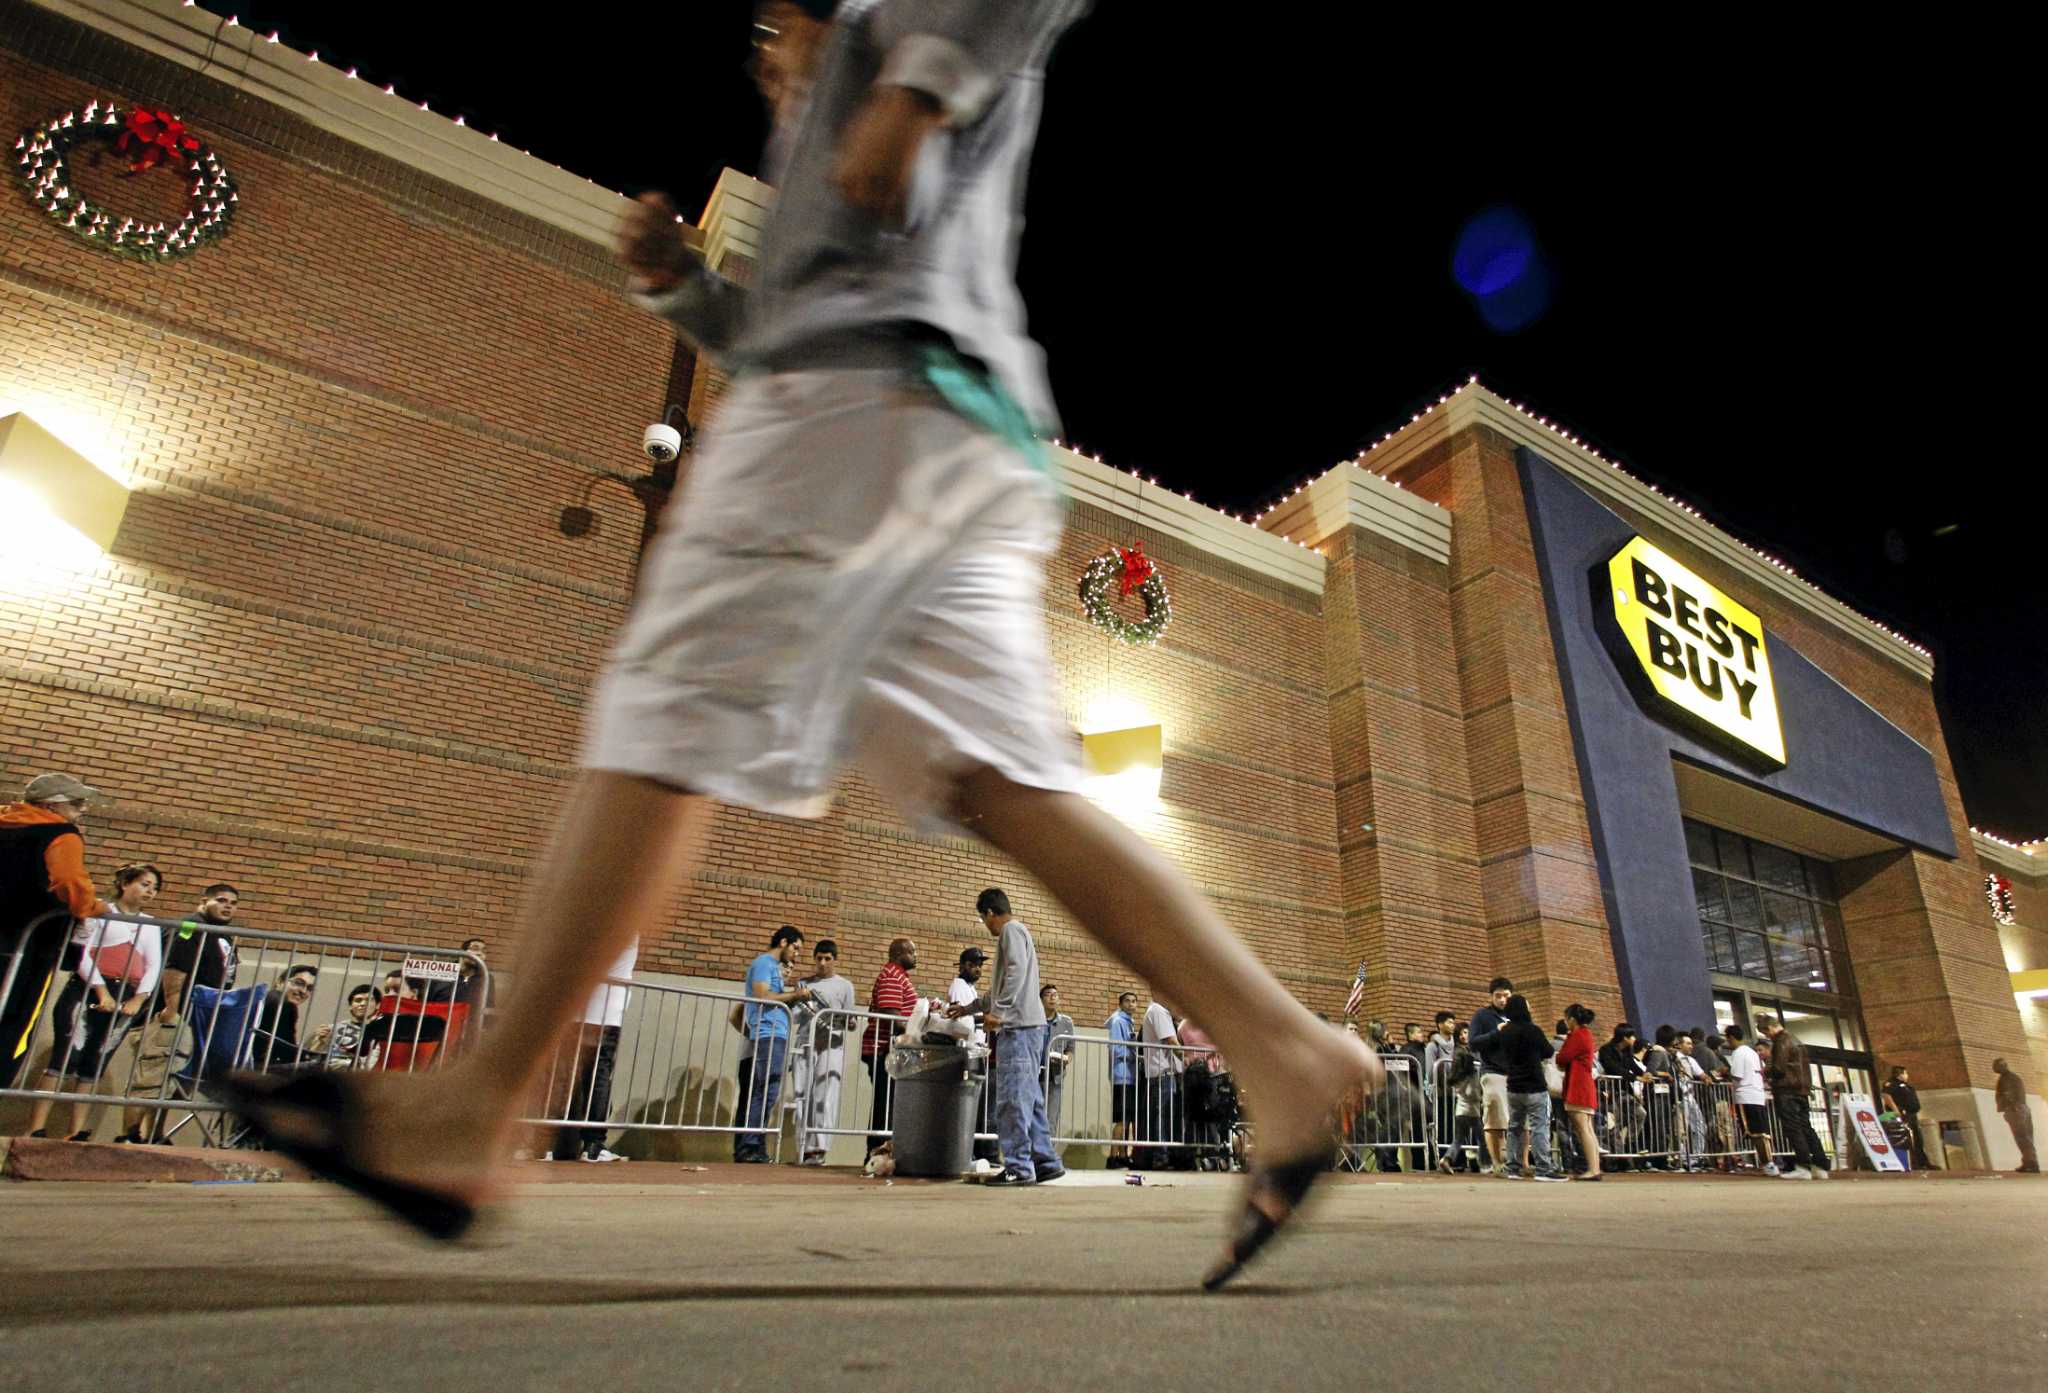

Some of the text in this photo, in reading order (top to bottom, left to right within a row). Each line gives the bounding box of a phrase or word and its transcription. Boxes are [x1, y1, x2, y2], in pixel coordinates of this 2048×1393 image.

[1631, 556, 1759, 673] BEST
[1646, 617, 1757, 720] BUY
[406, 960, 457, 972] NATIONAL
